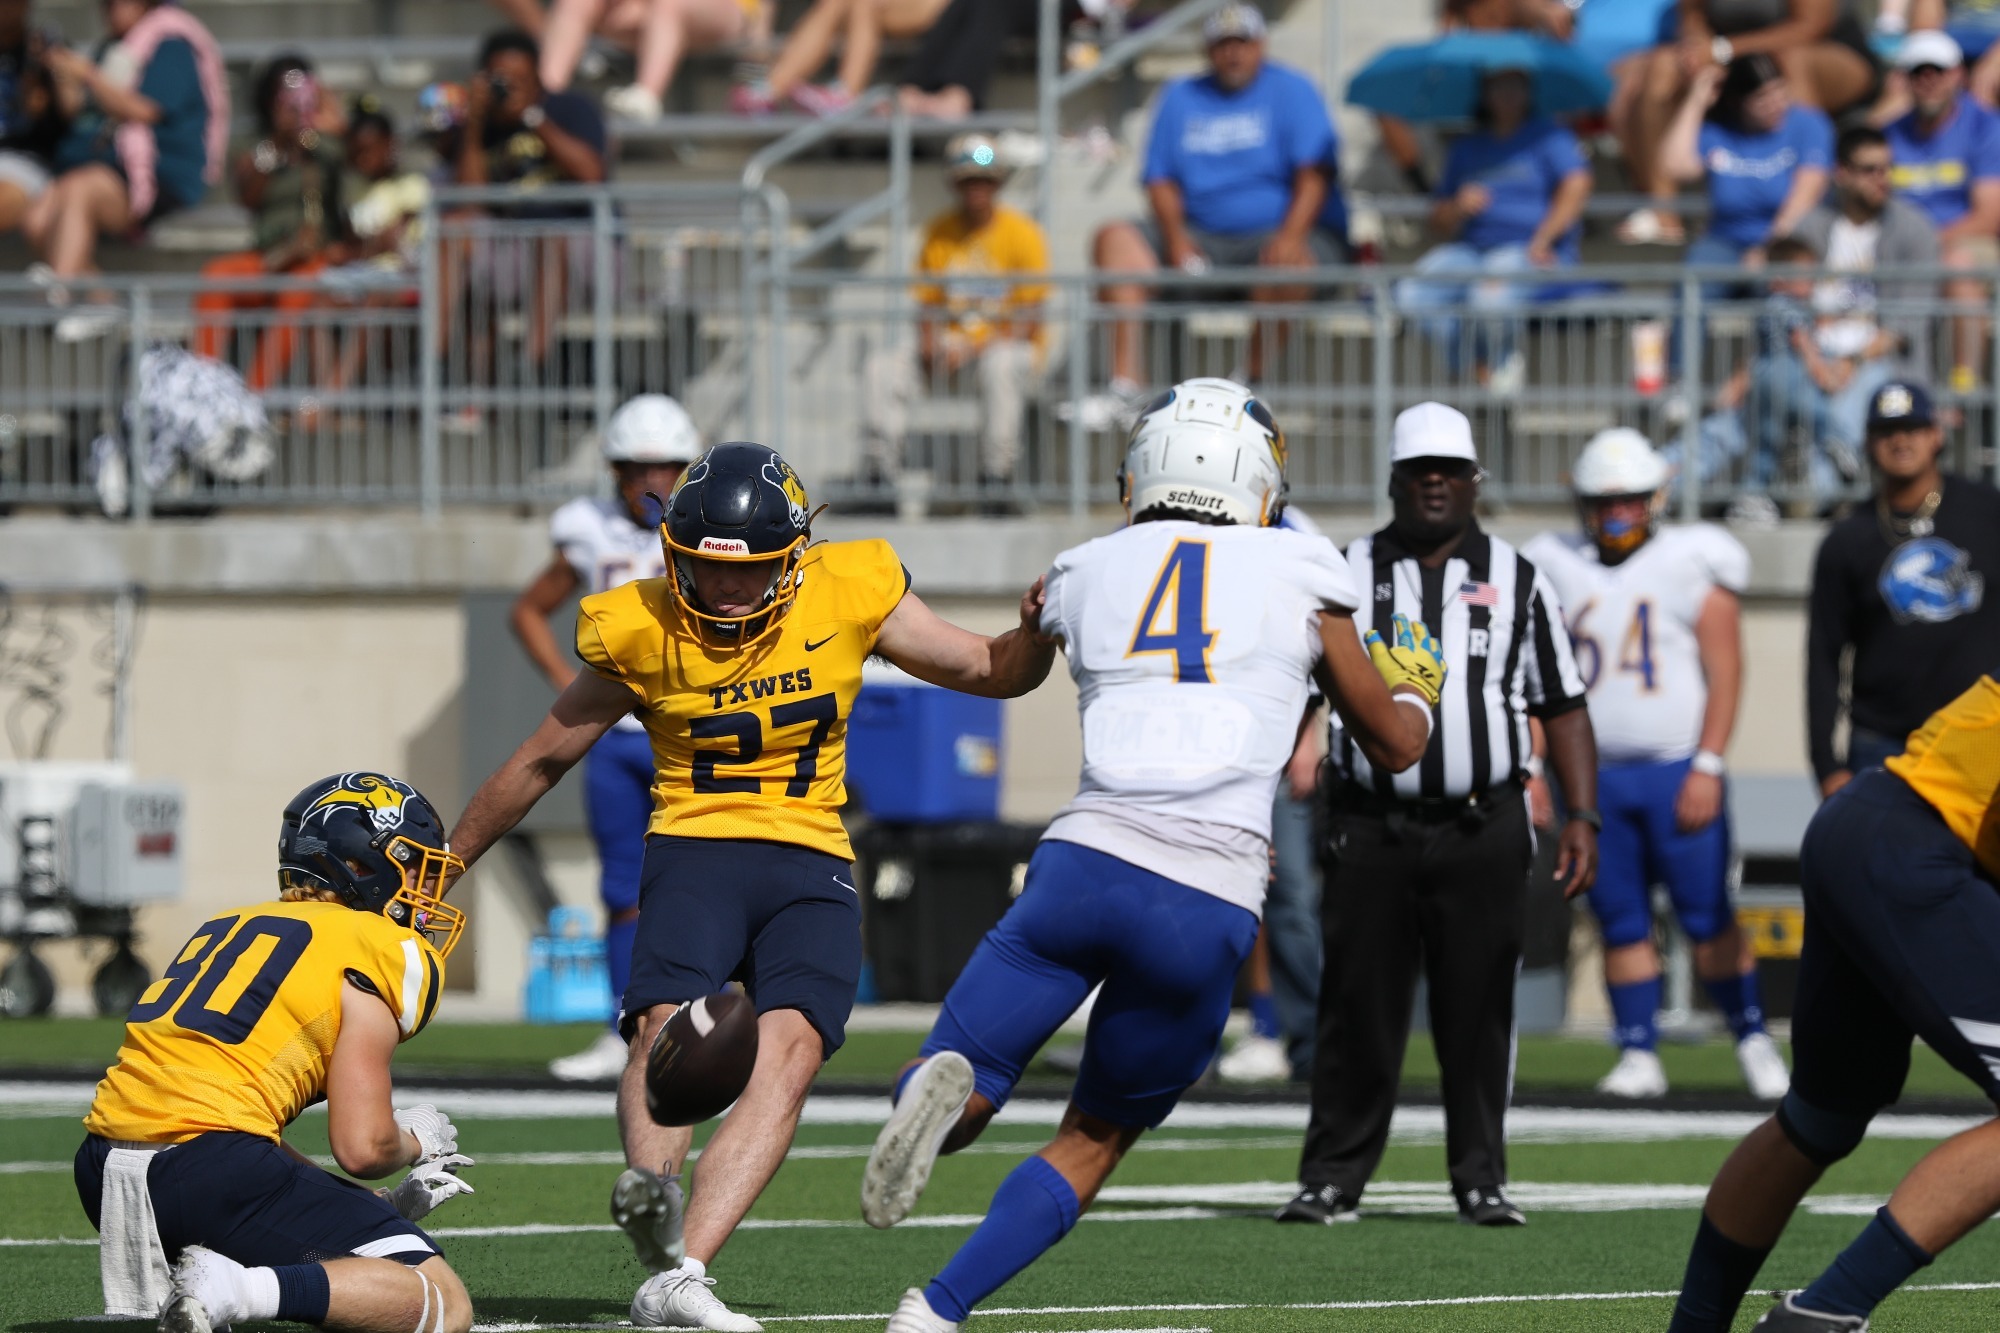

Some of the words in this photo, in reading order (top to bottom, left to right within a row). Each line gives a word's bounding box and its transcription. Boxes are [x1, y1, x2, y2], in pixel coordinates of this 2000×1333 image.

[1166, 489, 1224, 510] schutt
[703, 540, 743, 552] Riddell
[1123, 536, 1221, 684] 4
[1469, 628, 1489, 658] R
[708, 667, 813, 710] TXWES
[687, 691, 839, 798] 27
